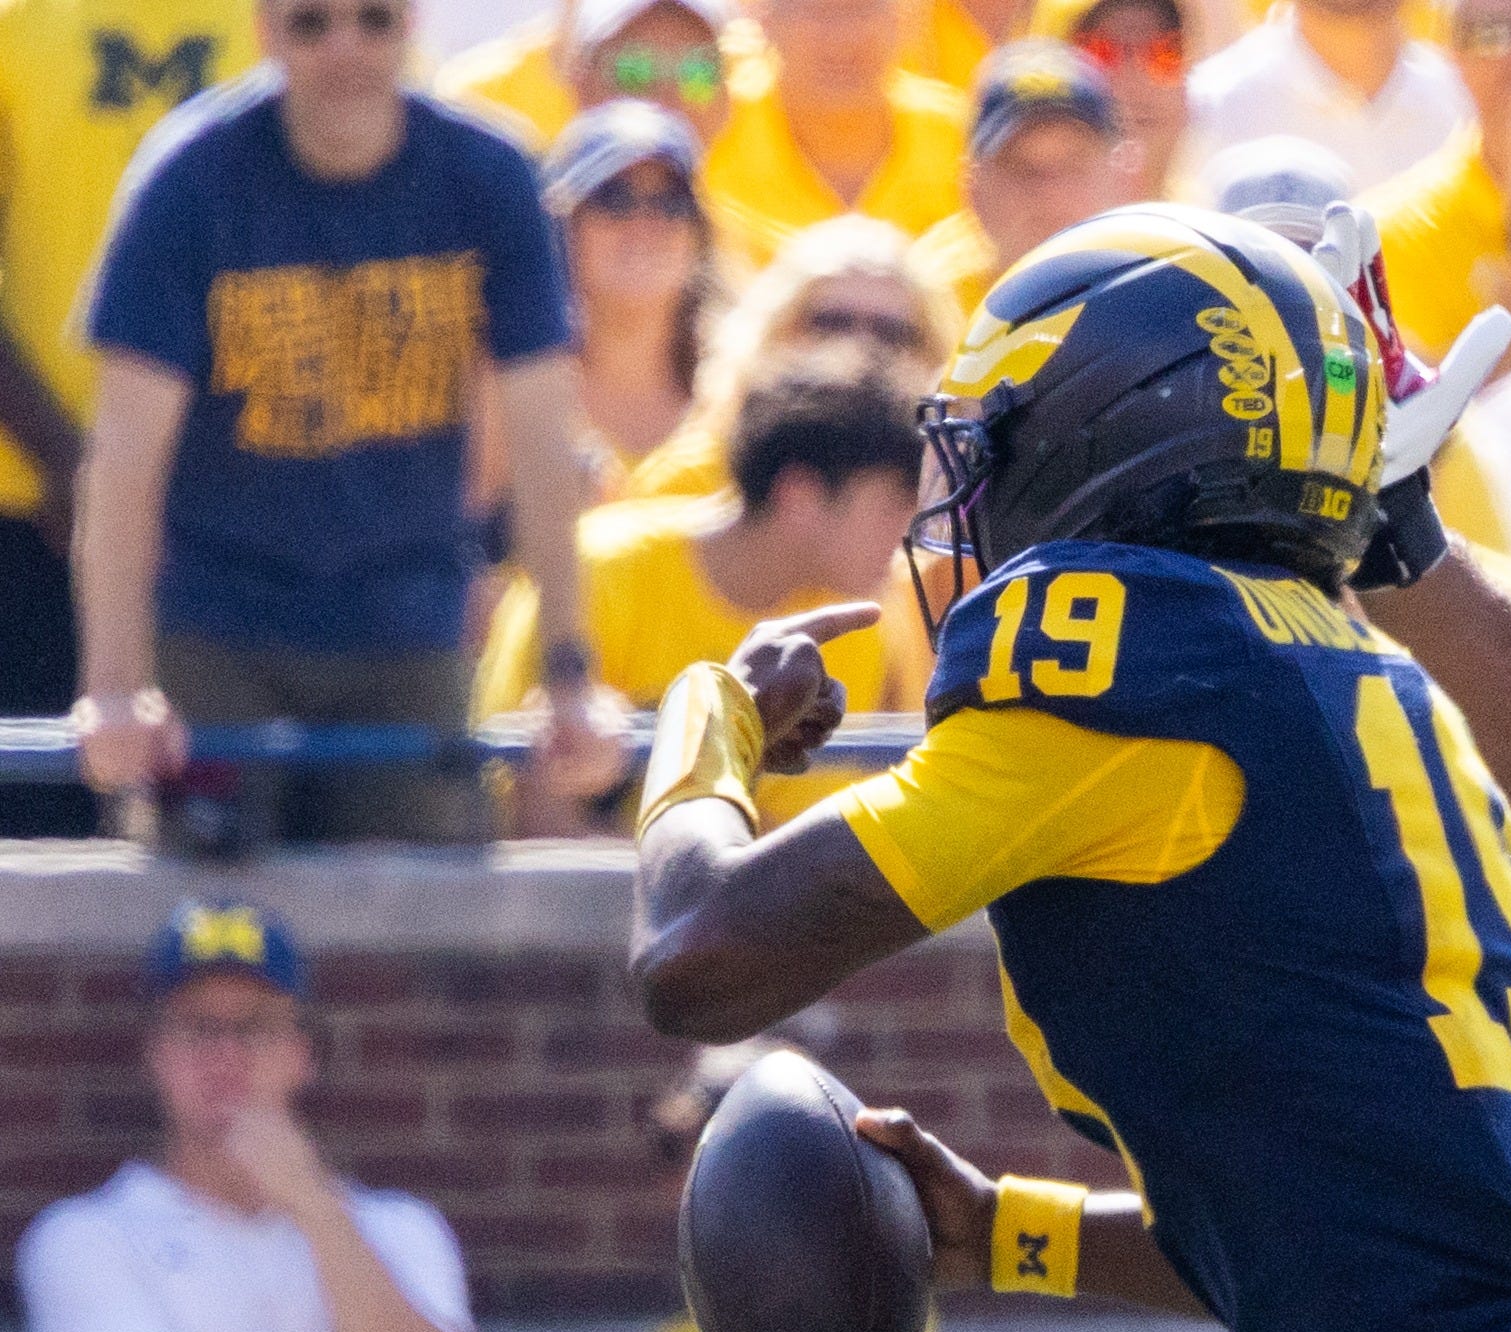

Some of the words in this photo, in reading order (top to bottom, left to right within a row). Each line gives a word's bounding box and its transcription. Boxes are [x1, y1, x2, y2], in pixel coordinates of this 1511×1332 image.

[1245, 426, 1273, 459] 19
[979, 571, 1127, 703] 19
[1017, 1231, 1049, 1278] M
